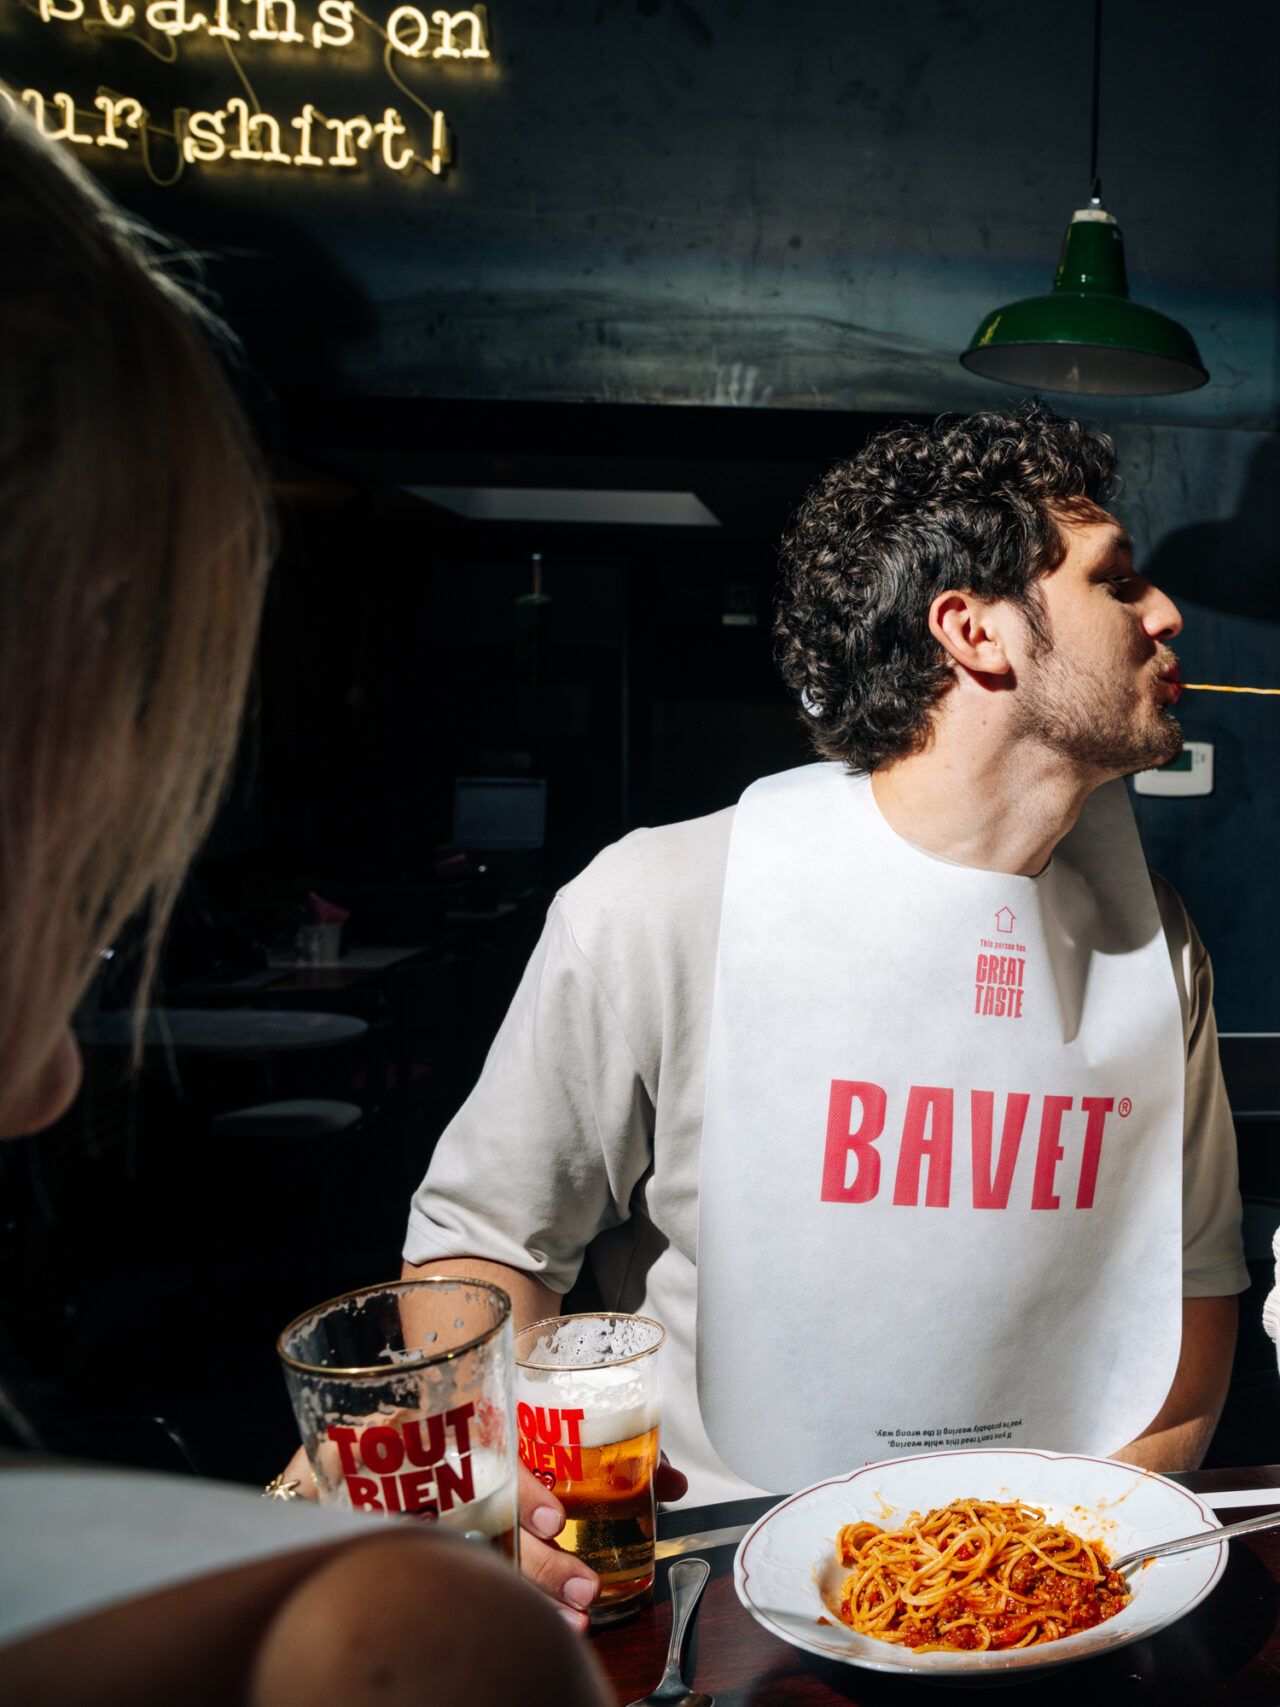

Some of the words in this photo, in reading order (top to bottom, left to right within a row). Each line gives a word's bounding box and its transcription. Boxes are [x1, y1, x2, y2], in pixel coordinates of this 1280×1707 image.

[387, 6, 491, 59] on
[0, 88, 143, 150] ur
[183, 97, 445, 175] shirt!
[975, 953, 1026, 988] GREAT
[975, 983, 1025, 1019] TASTE
[516, 1401, 585, 1446] OUT
[973, 1421, 1002, 1433] probably
[1002, 1419, 1022, 1429] you're
[875, 1429, 894, 1437] way.
[895, 1429, 921, 1437] wrong
[922, 1429, 935, 1437] the
[936, 1429, 942, 1437] it
[943, 1427, 972, 1436] wearing
[994, 1431, 1007, 1439] you
[326, 1401, 476, 1476] TOUT
[960, 1436, 976, 1445] read
[977, 1434, 994, 1443] can't
[923, 1439, 944, 1448] while
[345, 1454, 476, 1518] BIEN
